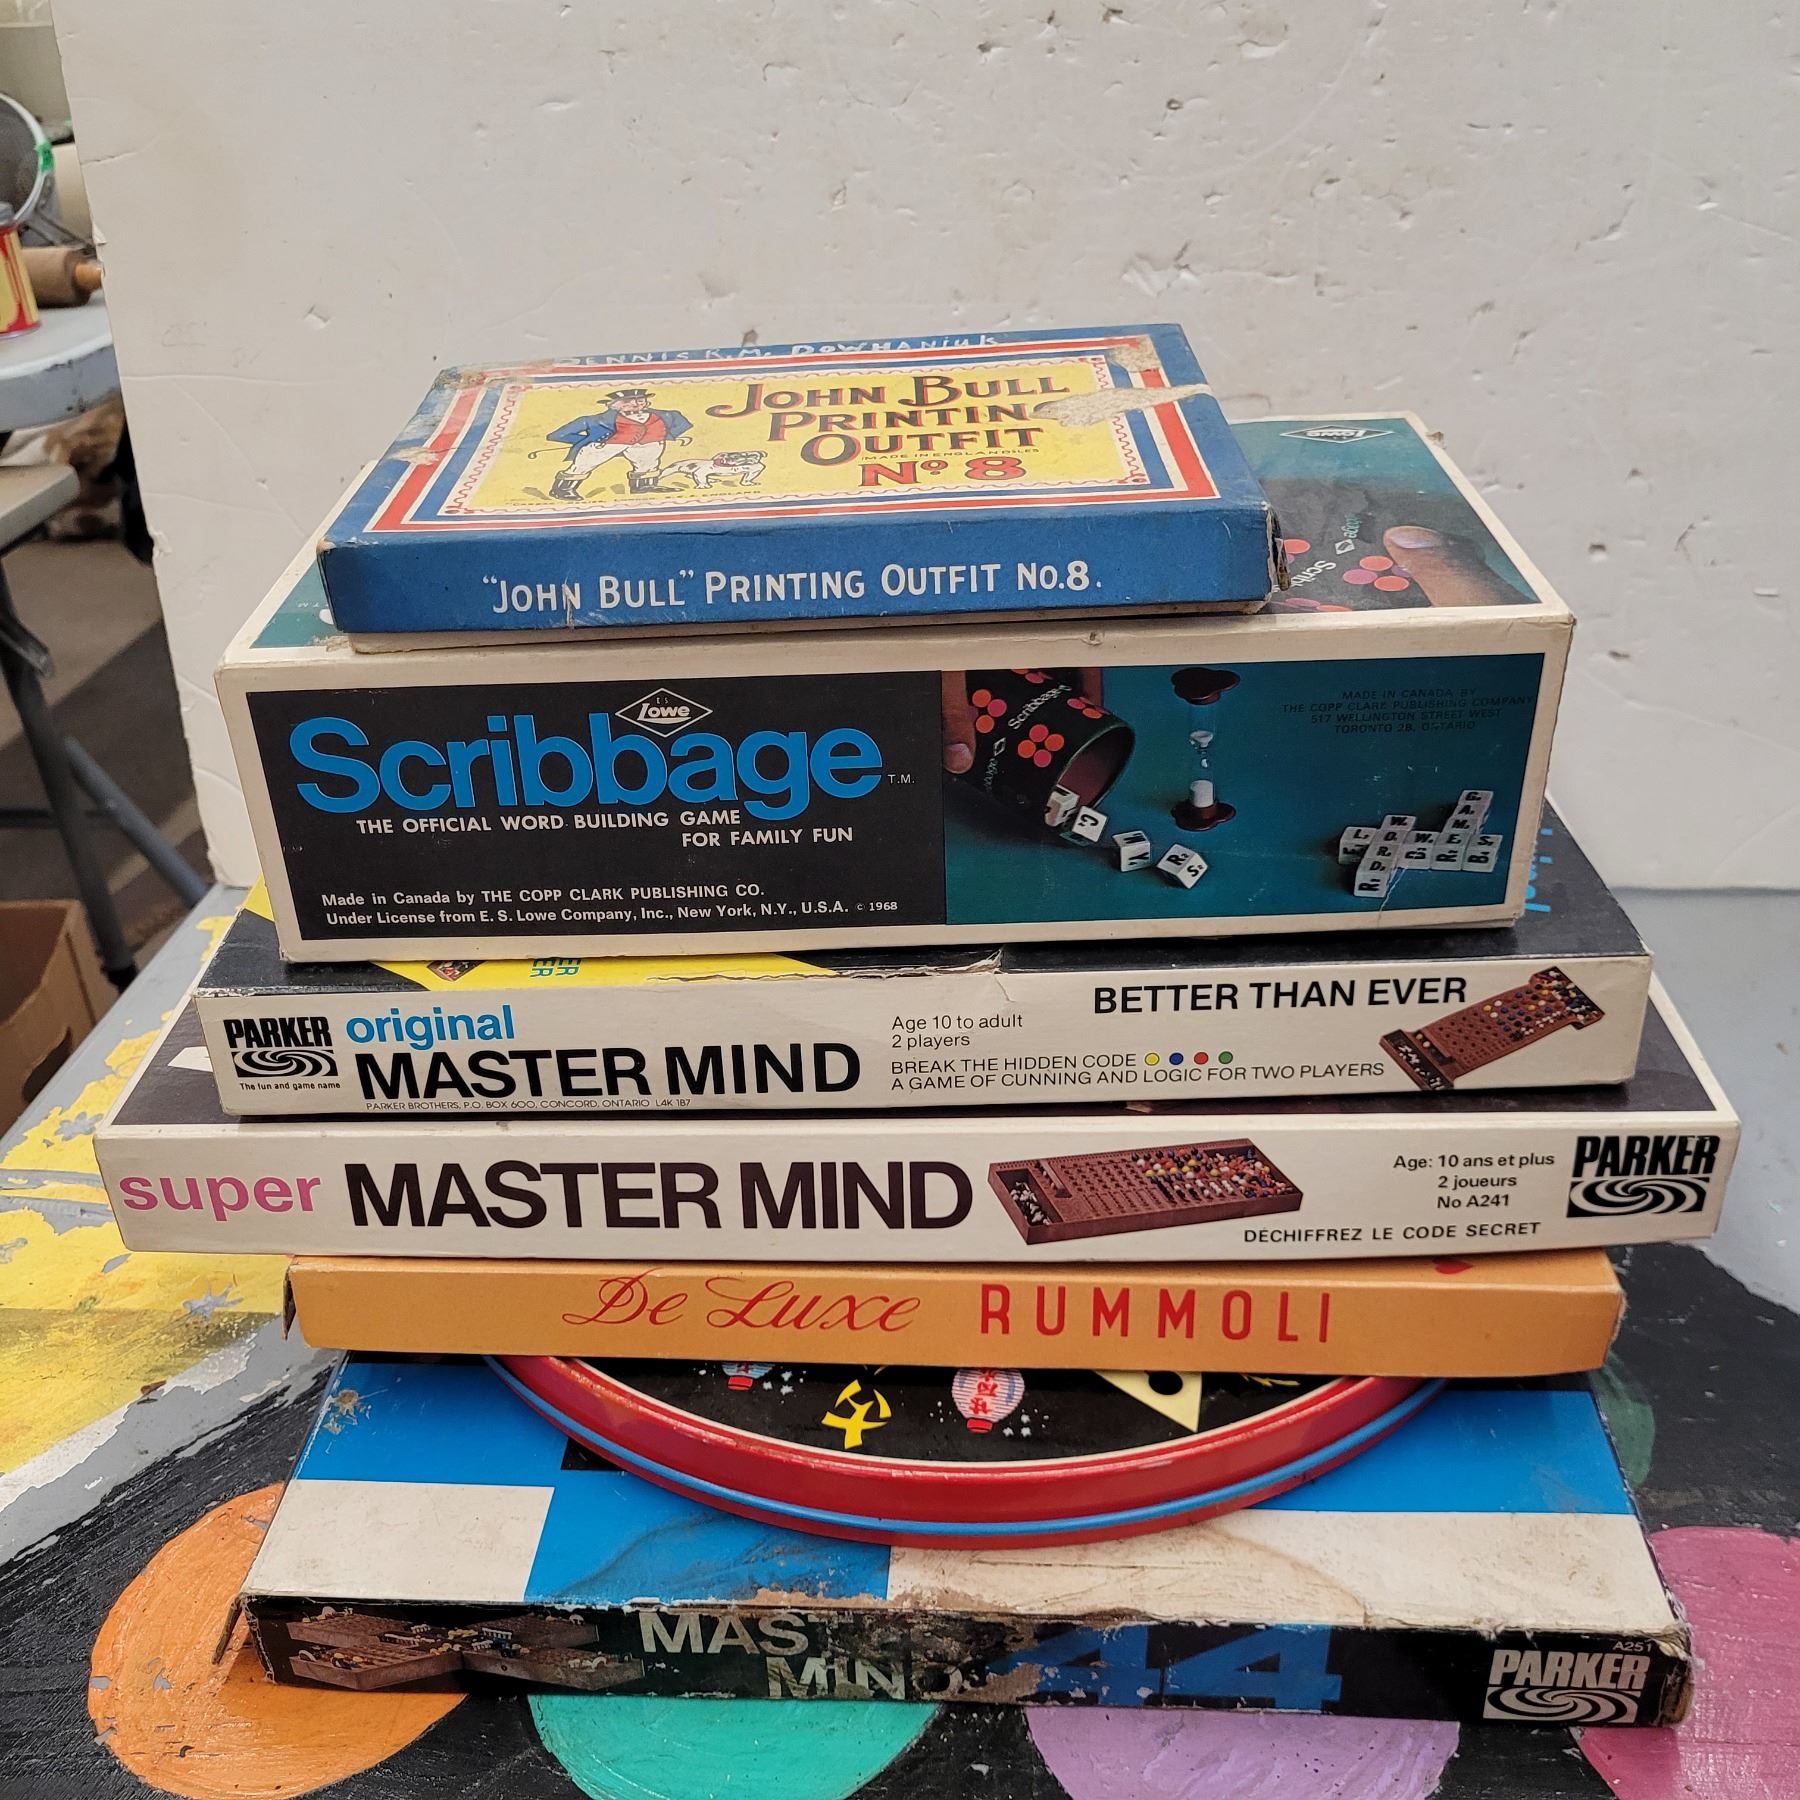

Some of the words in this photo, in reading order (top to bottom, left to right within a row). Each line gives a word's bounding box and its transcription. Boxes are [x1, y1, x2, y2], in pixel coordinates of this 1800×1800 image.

[705, 383, 885, 418] JOHN
[898, 375, 1070, 407] BULL
[800, 426, 1043, 467] OUTFIT
[964, 456, 1027, 481] 8
[705, 571, 865, 605] PRINTING
[881, 563, 1001, 596] OUTFIT
[1342, 689, 1377, 700] MADE
[1383, 689, 1396, 699] IN
[1401, 688, 1454, 698] CANADA
[637, 702, 692, 725] Lowe
[1280, 703, 1305, 713] THE
[1310, 702, 1343, 712] COPP
[1311, 714, 1332, 724] 517
[1337, 712, 1416, 723] WELLINGTON
[1469, 708, 1503, 719] WEST
[1335, 723, 1393, 734] TORONTO
[289, 712, 884, 822] Scribbage
[356, 818, 394, 834] THE
[402, 816, 492, 833] OFFICIAL
[500, 814, 564, 831] WORD
[574, 812, 669, 829] BUILDING
[680, 809, 741, 826] GAME
[682, 832, 721, 848] FOR
[730, 828, 803, 846] FAMILY
[812, 827, 853, 843] FUN
[321, 892, 365, 906] Made
[371, 892, 387, 905] in
[393, 890, 451, 905] Canada
[456, 890, 475, 906] by
[481, 890, 513, 903] THE
[519, 889, 563, 902] COPP
[569, 888, 624, 901] CLARK
[631, 884, 728, 900] PUBLISHING
[735, 883, 765, 897] CO.
[326, 911, 373, 925] Under
[376, 911, 436, 924] License
[439, 909, 476, 923] from
[480, 910, 495, 922] E.
[498, 910, 513, 922] S.
[517, 909, 557, 922] Lowe
[561, 907, 637, 923] Company,
[641, 906, 673, 921] Inc.,
[678, 905, 712, 919] New
[715, 903, 757, 918] York,
[761, 903, 797, 917] N.Y.,
[801, 901, 849, 915] U.S.A.
[869, 901, 898, 912] 1968
[1094, 982, 1239, 1014] BETTER
[1249, 979, 1356, 1009] THAN
[1367, 976, 1468, 1006] EVER
[223, 1016, 333, 1049] PARKER
[345, 1004, 516, 1050] original
[891, 1015, 928, 1033] Age
[931, 1014, 952, 1030] 10
[957, 1014, 974, 1030] to
[978, 1013, 1024, 1028] adult
[891, 1034, 902, 1049] 2
[906, 1032, 971, 1051] players
[354, 1046, 653, 1100] MASTER
[664, 1043, 861, 1095] MIND
[891, 1059, 956, 1075] BREAK
[960, 1057, 999, 1073] THE
[1003, 1055, 1077, 1071] HIDDEN
[1082, 1053, 1137, 1069] CODE
[239, 1082, 256, 1091] The
[258, 1082, 273, 1090] fun
[274, 1082, 290, 1090] and
[292, 1082, 316, 1091] game
[317, 1081, 341, 1089] name
[891, 1077, 905, 1091] A
[908, 1075, 965, 1090] GAME
[970, 1074, 997, 1088] OF
[1001, 1071, 1092, 1087] CUNNING
[1096, 1069, 1138, 1084] AND
[1142, 1067, 1202, 1083] LOGIC
[1207, 1066, 1247, 1081] FOR
[1250, 1065, 1295, 1080] TWO
[1299, 1062, 1385, 1079] PLAYERS
[366, 1101, 406, 1111] PARKER
[408, 1101, 462, 1111] BROTHERS,
[486, 1100, 509, 1110] BOX
[602, 1098, 650, 1108] ONTARIO
[655, 1098, 674, 1107] L4K
[676, 1098, 691, 1107] 1B7
[1393, 1154, 1433, 1172] Age:
[1438, 1154, 1459, 1168] 10
[1462, 1155, 1494, 1168] ans
[1497, 1154, 1515, 1167] et
[1518, 1152, 1555, 1169] plus
[1571, 1134, 1721, 1178] PARKER
[1437, 1175, 1448, 1188] 2
[1452, 1174, 1518, 1191] joueurs
[118, 1174, 321, 1222] super
[344, 1159, 722, 1229] MASTER
[739, 1161, 973, 1230] MIND
[1437, 1195, 1462, 1209] No
[1466, 1193, 1510, 1208] A241
[1372, 1226, 1394, 1241] LE
[1402, 1224, 1457, 1240] CODE
[1465, 1221, 1542, 1238] SECRET
[562, 1268, 689, 1330] De
[706, 1278, 924, 1333] Luxe
[981, 1283, 1330, 1344] RUMMOLI
[639, 1610, 853, 1657] MAS
[1612, 1640, 1652, 1652] A251
[1488, 1649, 1651, 1690] PARKER
